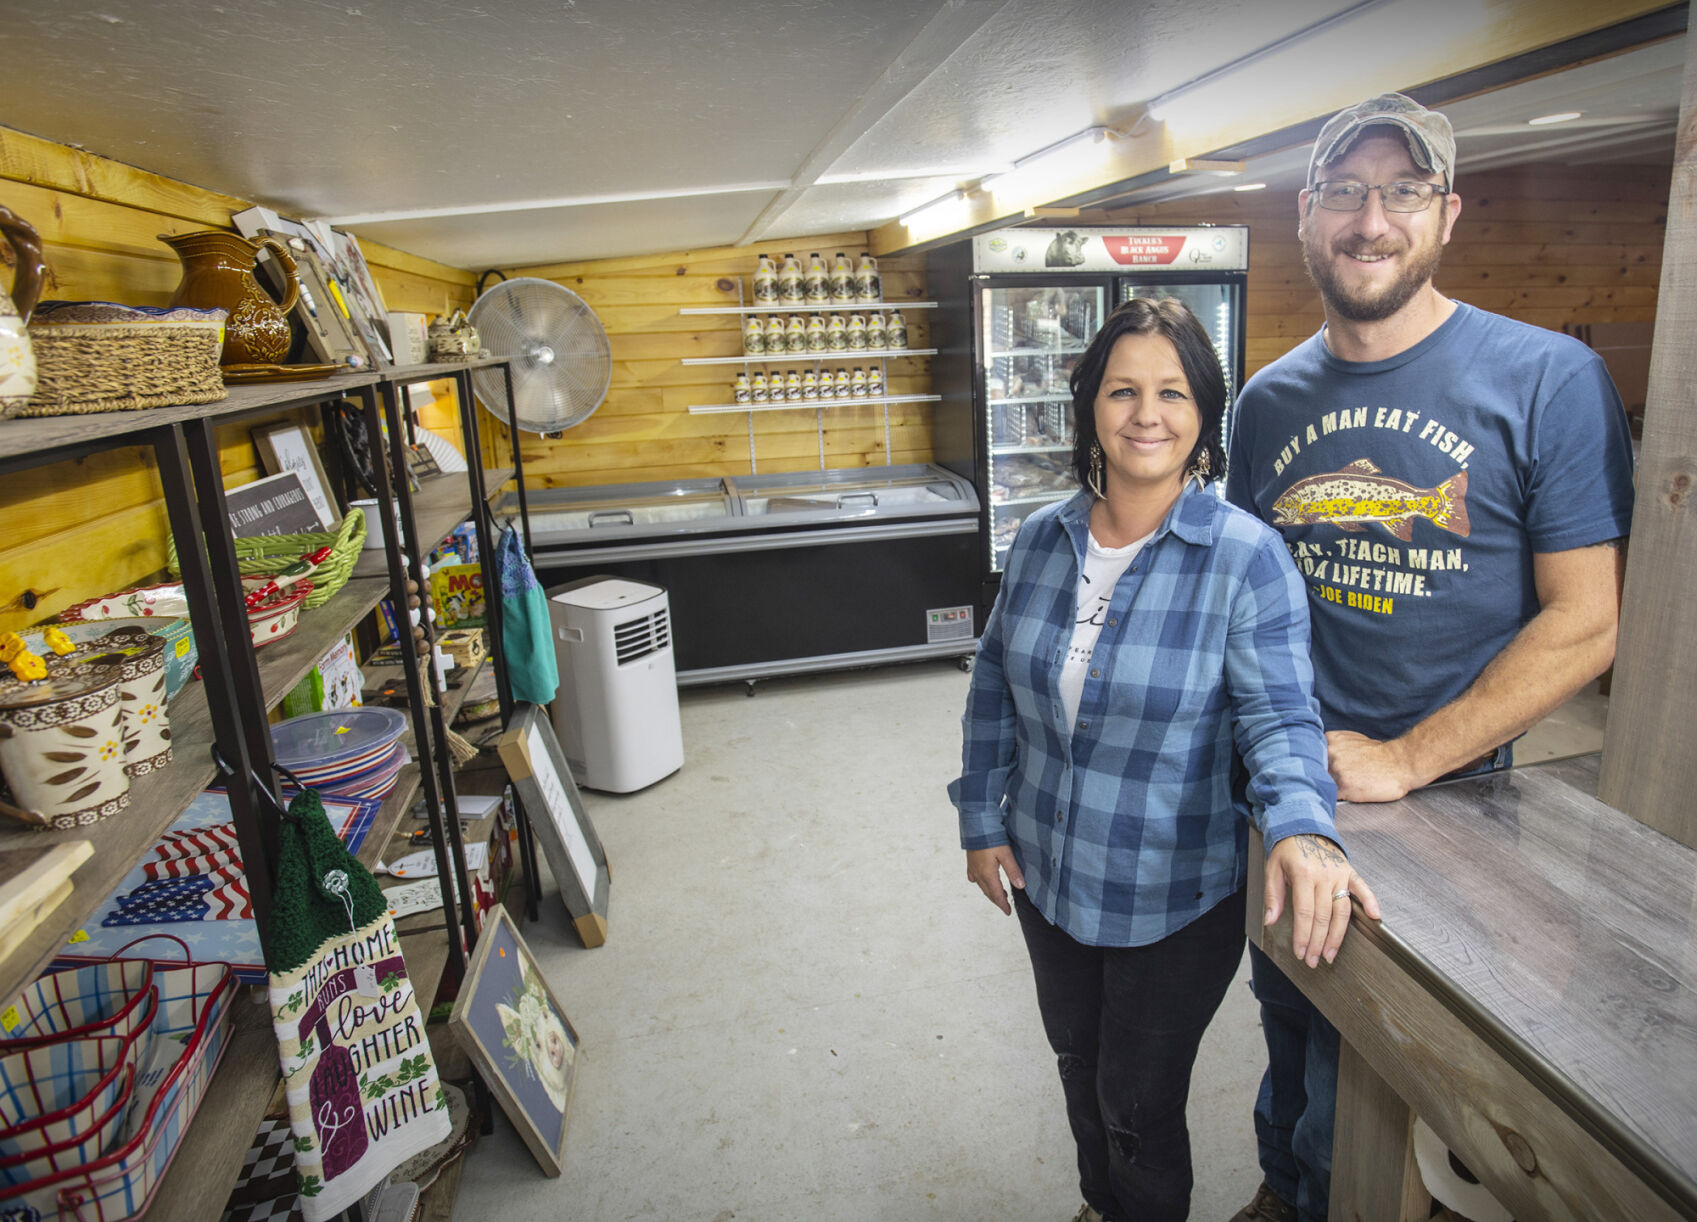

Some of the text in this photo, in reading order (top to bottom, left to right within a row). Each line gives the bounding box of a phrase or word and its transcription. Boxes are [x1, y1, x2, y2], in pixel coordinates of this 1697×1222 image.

[1120, 246, 1169, 254] BLACK ANGUS
[1132, 255, 1158, 263] RANCH
[1273, 406, 1475, 476] BUY A MAN EAT FISH,
[260, 499, 275, 515] AND
[1335, 538, 1401, 566] TEACH
[1408, 548, 1469, 573] MAN,
[1314, 560, 1329, 580] A
[1332, 562, 1432, 597] LIFETIME.
[1348, 592, 1393, 615] BIDEN
[301, 923, 395, 1008] THIS HOME
[317, 974, 347, 1008] RUNS
[329, 990, 414, 1043] love
[313, 1015, 421, 1108] LAUGHTER
[319, 1078, 435, 1156] & WINE
